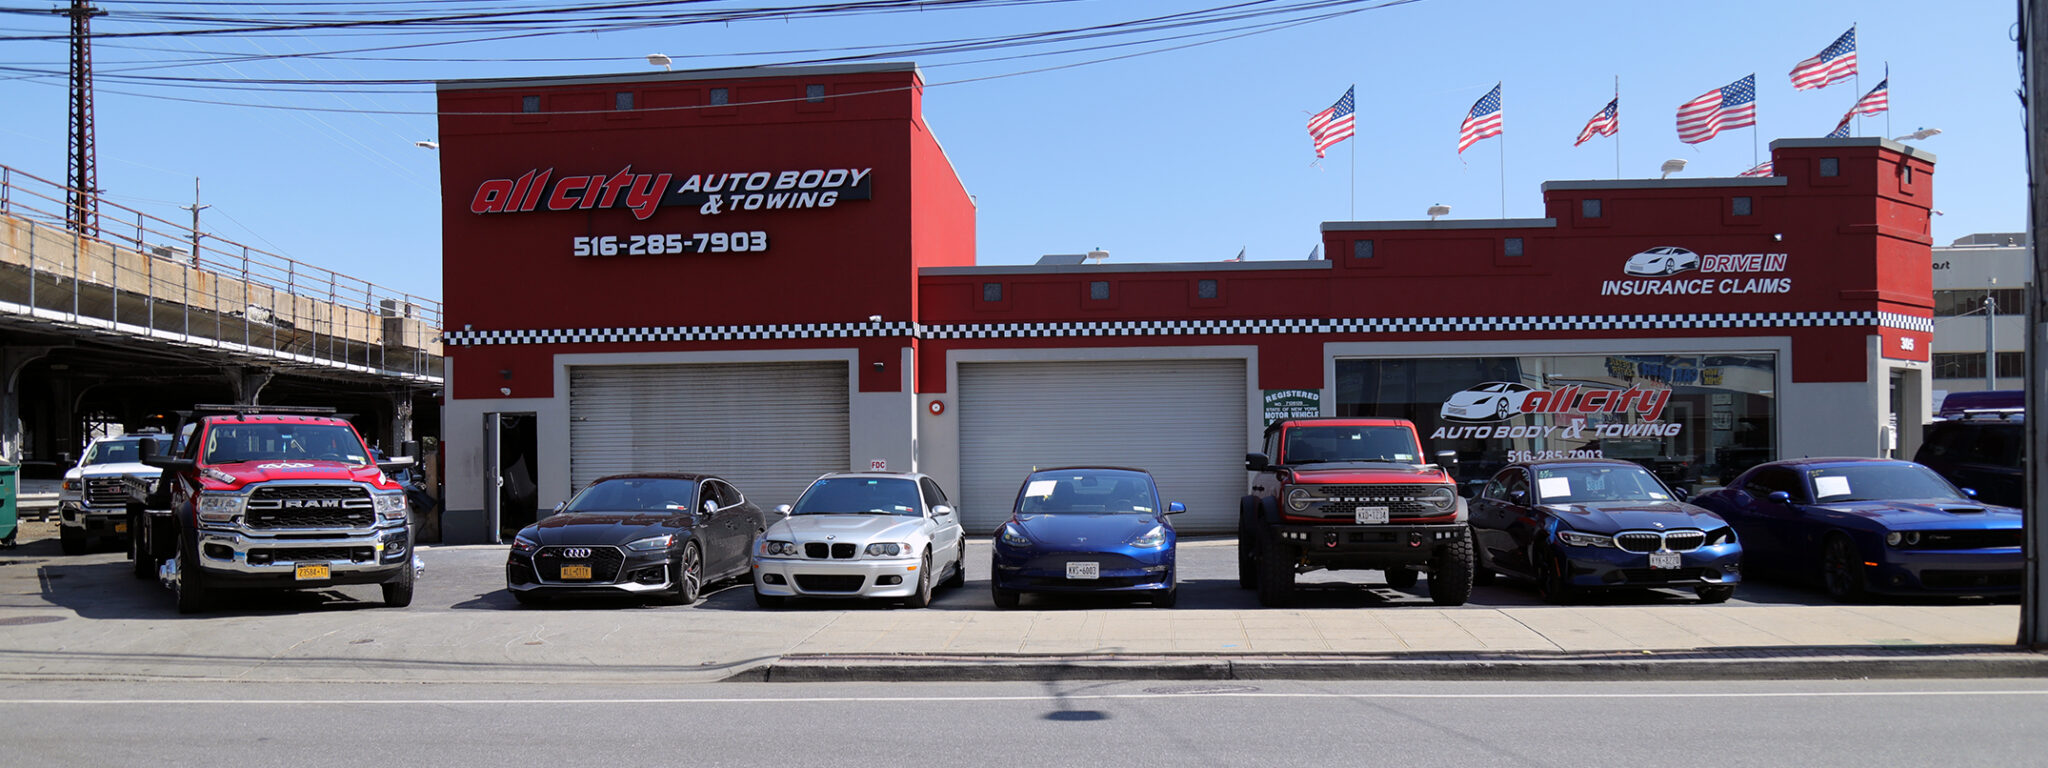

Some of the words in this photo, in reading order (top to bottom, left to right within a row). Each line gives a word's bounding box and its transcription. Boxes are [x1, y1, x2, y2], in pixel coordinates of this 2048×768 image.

[677, 172, 771, 193] AUTO
[774, 168, 872, 190] BODY
[700, 194, 723, 215] &
[730, 191, 838, 211] TOWING
[574, 231, 767, 256] 516-285-7903
[1701, 254, 1763, 272] DRIVE
[1763, 254, 1787, 272] IN
[1601, 279, 1714, 295] INSURANCE
[1719, 278, 1791, 294] CLAIMS
[1265, 390, 1319, 403] REGISTERED
[1430, 426, 1491, 439] AUTO
[1493, 425, 1554, 439] BODY
[1562, 418, 1584, 439] &
[1595, 423, 1682, 437] TOWING
[1507, 450, 1603, 462] 516-285-7903
[871, 461, 885, 469] FDC
[285, 500, 338, 508] RAM
